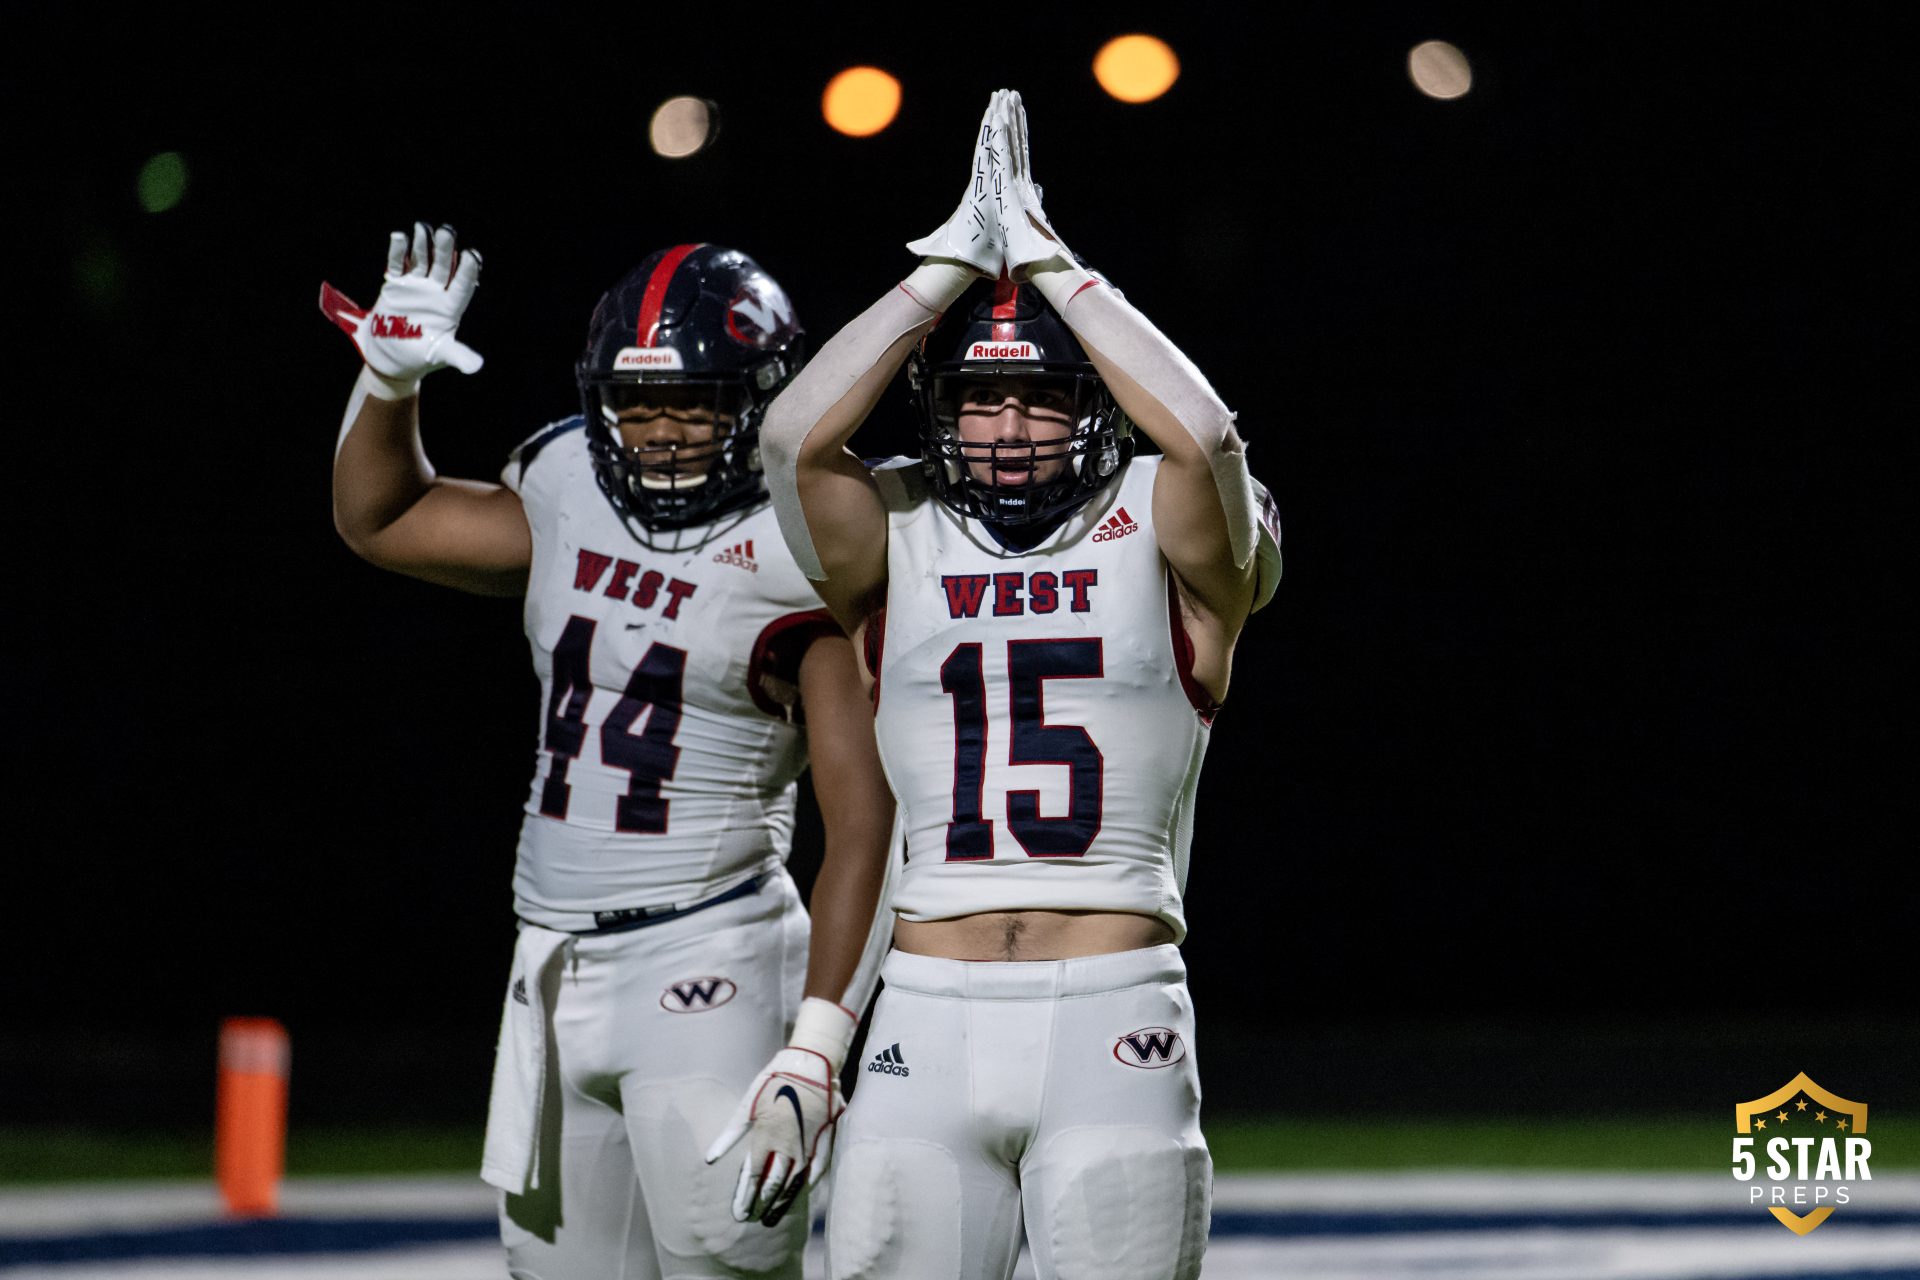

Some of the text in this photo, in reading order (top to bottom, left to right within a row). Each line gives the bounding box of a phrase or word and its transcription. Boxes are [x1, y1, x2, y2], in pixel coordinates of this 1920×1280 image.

[621, 354, 672, 365] Riddell
[973, 344, 1030, 358] Riddell
[1092, 522, 1138, 543] adidas
[713, 553, 758, 573] adidas
[573, 548, 698, 621] WEST
[941, 569, 1098, 619] WEST
[539, 614, 688, 835] 44
[940, 637, 1104, 862] 15
[671, 980, 721, 1008] W
[1119, 1032, 1179, 1063] W
[868, 1061, 910, 1078] adidas
